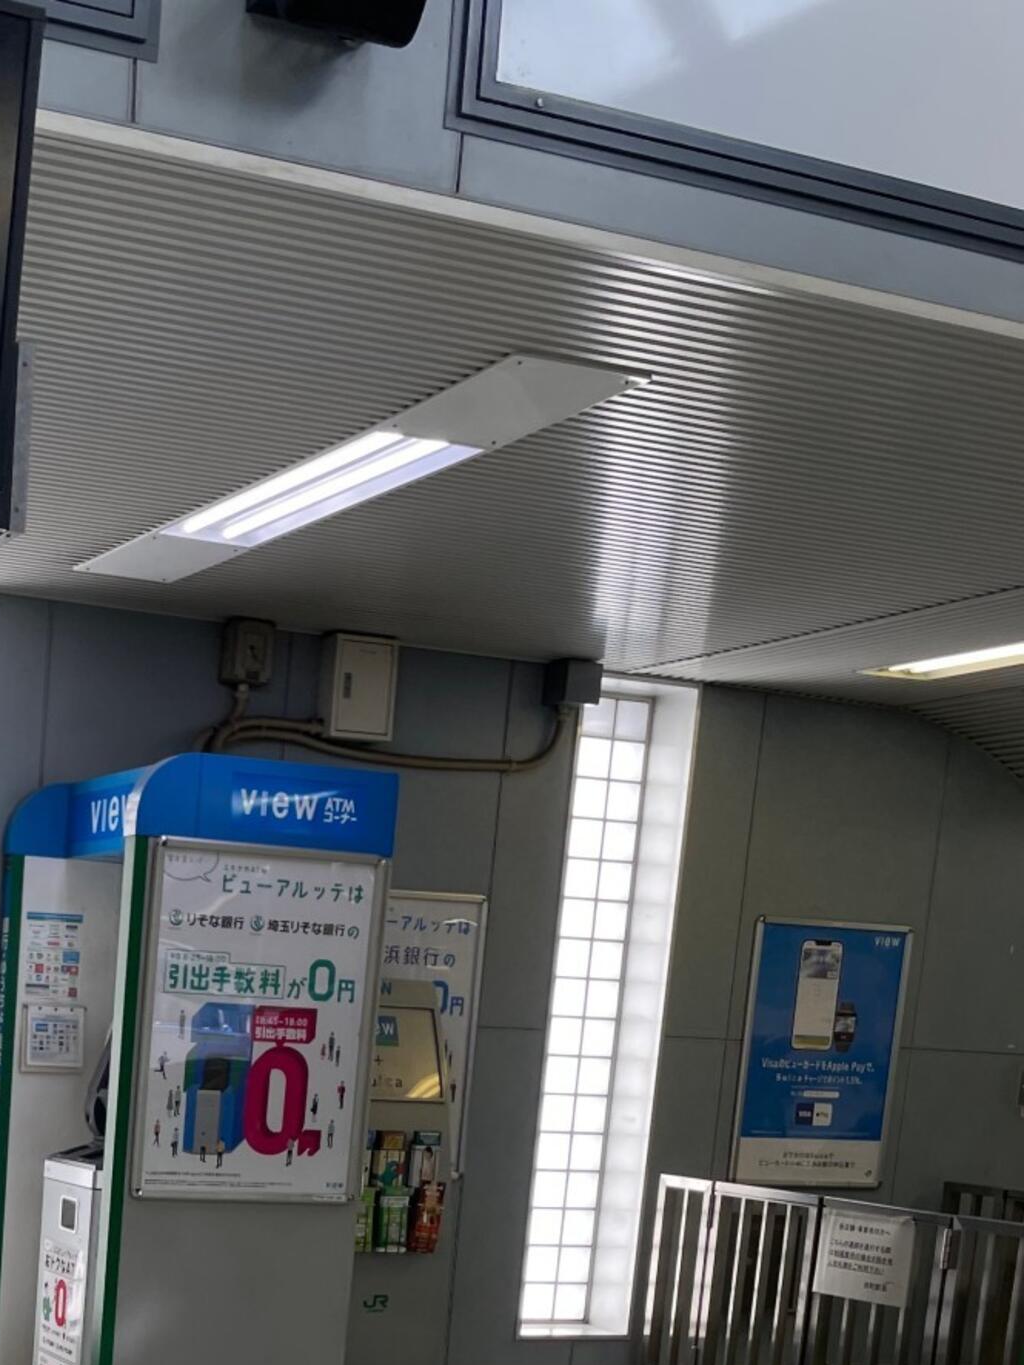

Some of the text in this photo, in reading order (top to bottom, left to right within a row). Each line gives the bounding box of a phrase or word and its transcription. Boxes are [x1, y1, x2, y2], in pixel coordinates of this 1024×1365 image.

[324, 797, 356, 813] ATM
[322, 810, 358, 823] コーナー
[222, 873, 365, 903] ビューアルッテは
[186, 913, 245, 930] りそな銀行
[362, 1294, 389, 1309] JR
